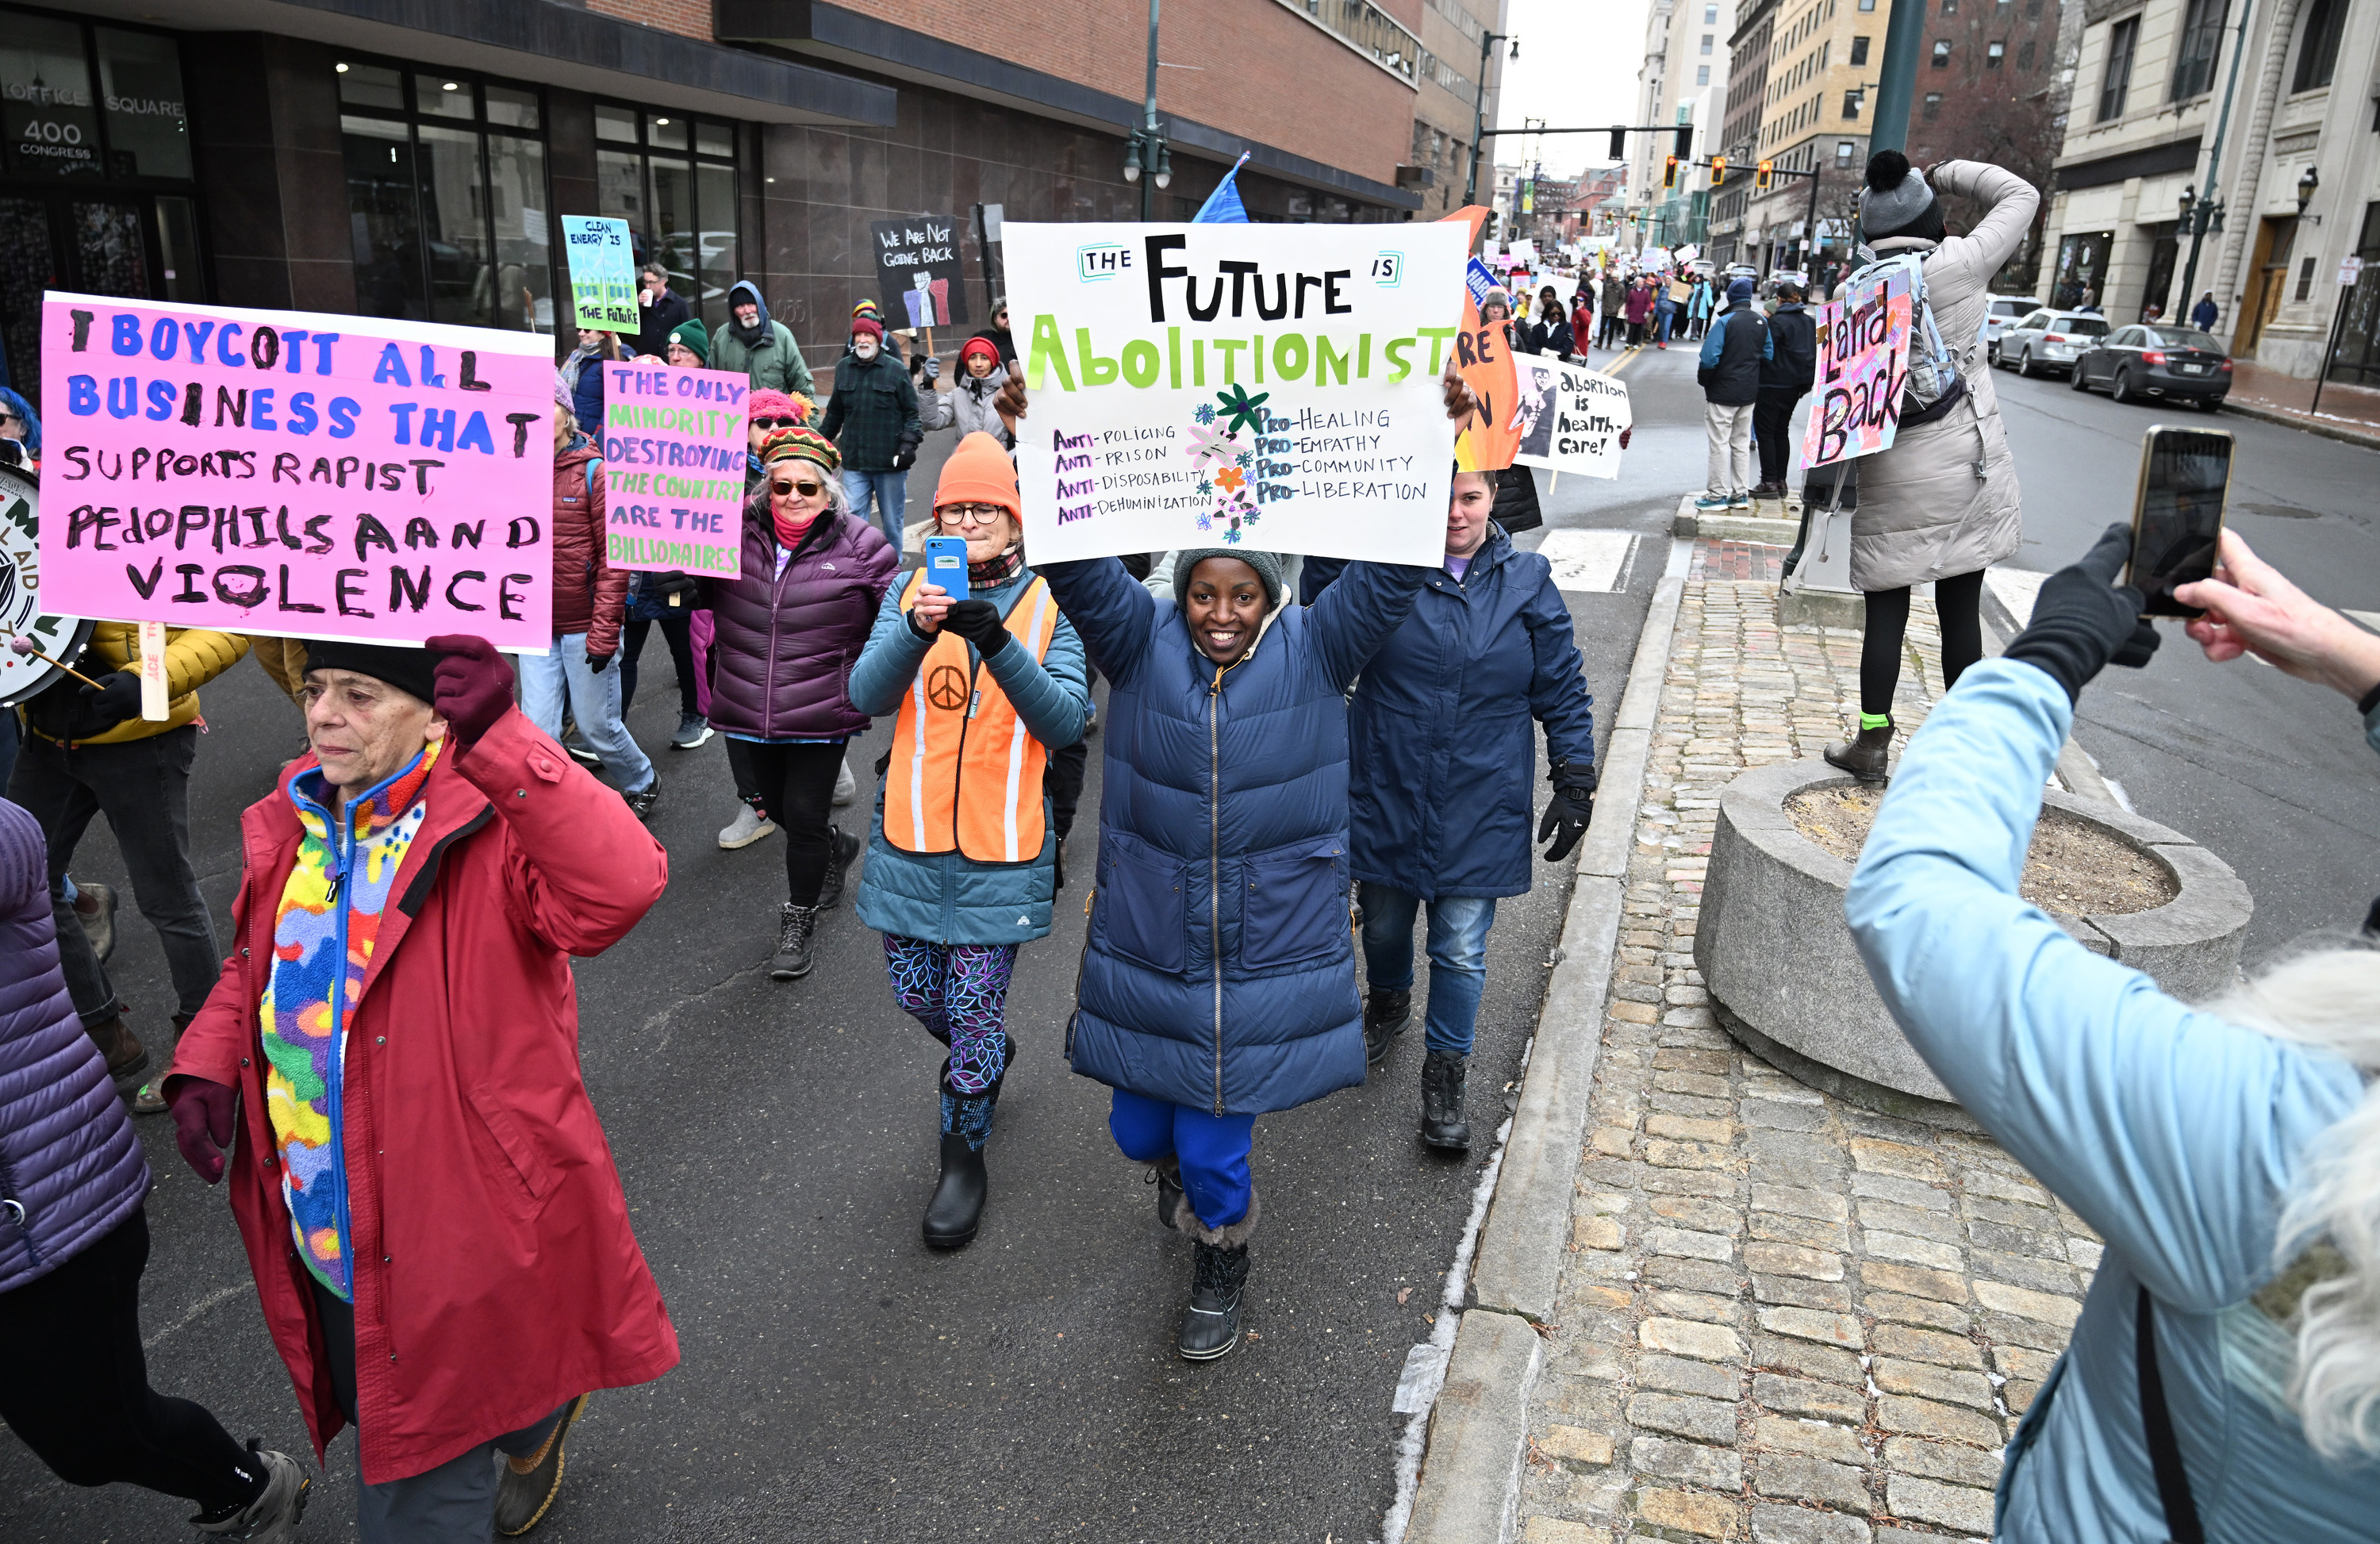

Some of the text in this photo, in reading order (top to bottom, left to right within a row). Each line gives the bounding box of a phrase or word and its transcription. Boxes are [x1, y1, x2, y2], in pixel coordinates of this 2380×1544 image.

[10, 83, 185, 117] OFFICE SQUARE
[25, 121, 81, 144] 400
[21, 144, 91, 159] CONGRESS
[570, 234, 620, 246] ENERGY IS
[585, 221, 612, 233] CLEAN
[880, 223, 950, 248] WE ARE NOT
[883, 247, 954, 267] GOING BACK
[1086, 251, 1132, 271] THE
[1371, 259, 1393, 277] IS
[579, 305, 603, 319] THE
[69, 309, 492, 391] I BOYCOTT ALL
[1457, 330, 1494, 368] RE
[612, 370, 746, 405] THE ONLY
[1575, 395, 1589, 411] is
[67, 374, 542, 458] BUSINESS THAT
[608, 403, 743, 438] MINORITY
[1816, 349, 1906, 466] Back
[62, 446, 445, 495] SUPPORTS RAPIST
[606, 437, 746, 472] DESTROYING
[0, 476, 26, 494] ANS
[0, 486, 22, 498] HEADS
[608, 470, 745, 502] THE COUNTRY
[609, 505, 724, 533] ARE THE
[607, 533, 740, 574] BILLIONAIRES
[13, 551, 39, 590] AID
[126, 557, 533, 620] VIOLENCE
[147, 621, 159, 682] ACE Th
